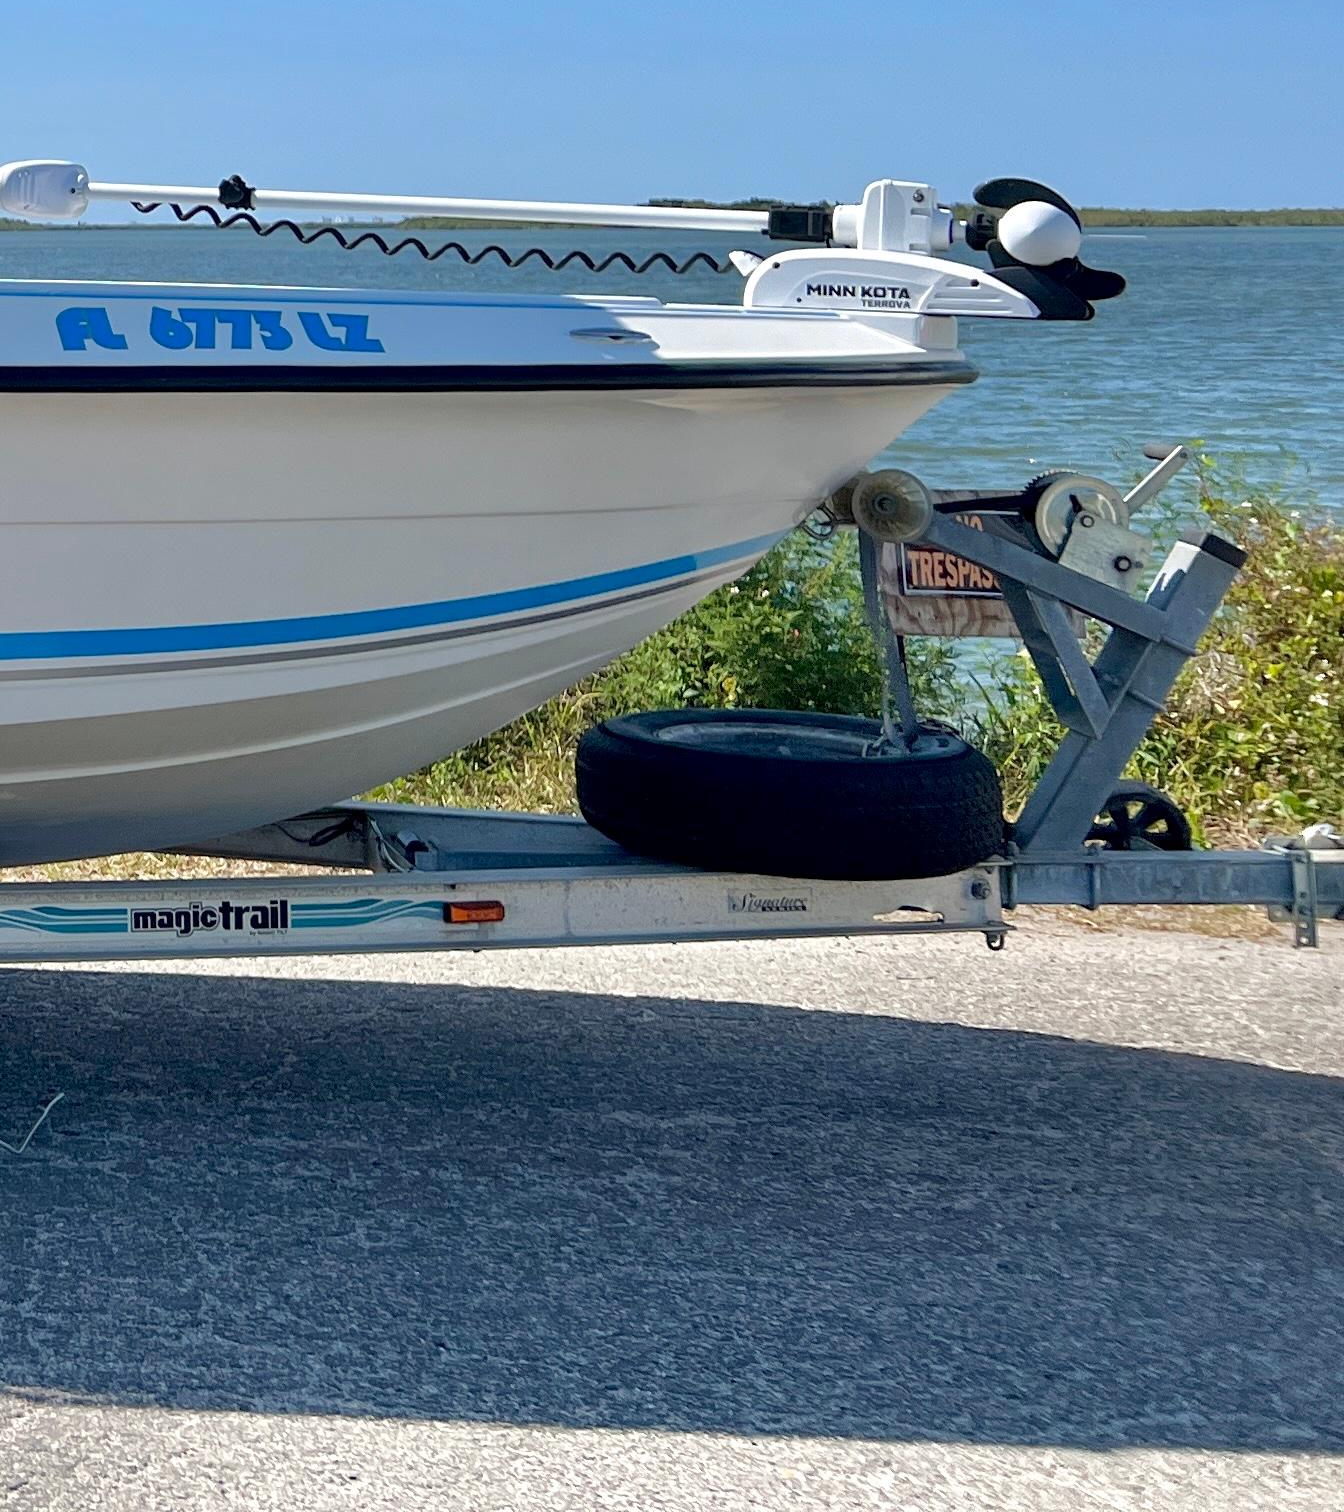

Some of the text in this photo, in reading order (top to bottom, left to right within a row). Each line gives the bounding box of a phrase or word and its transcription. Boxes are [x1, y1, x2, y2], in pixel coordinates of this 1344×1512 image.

[806, 283, 911, 299] MINN KOTA
[861, 299, 911, 309] TERROVA
[55, 306, 129, 351] FL
[297, 311, 386, 354] LZ
[906, 549, 1001, 589] TRESPAS
